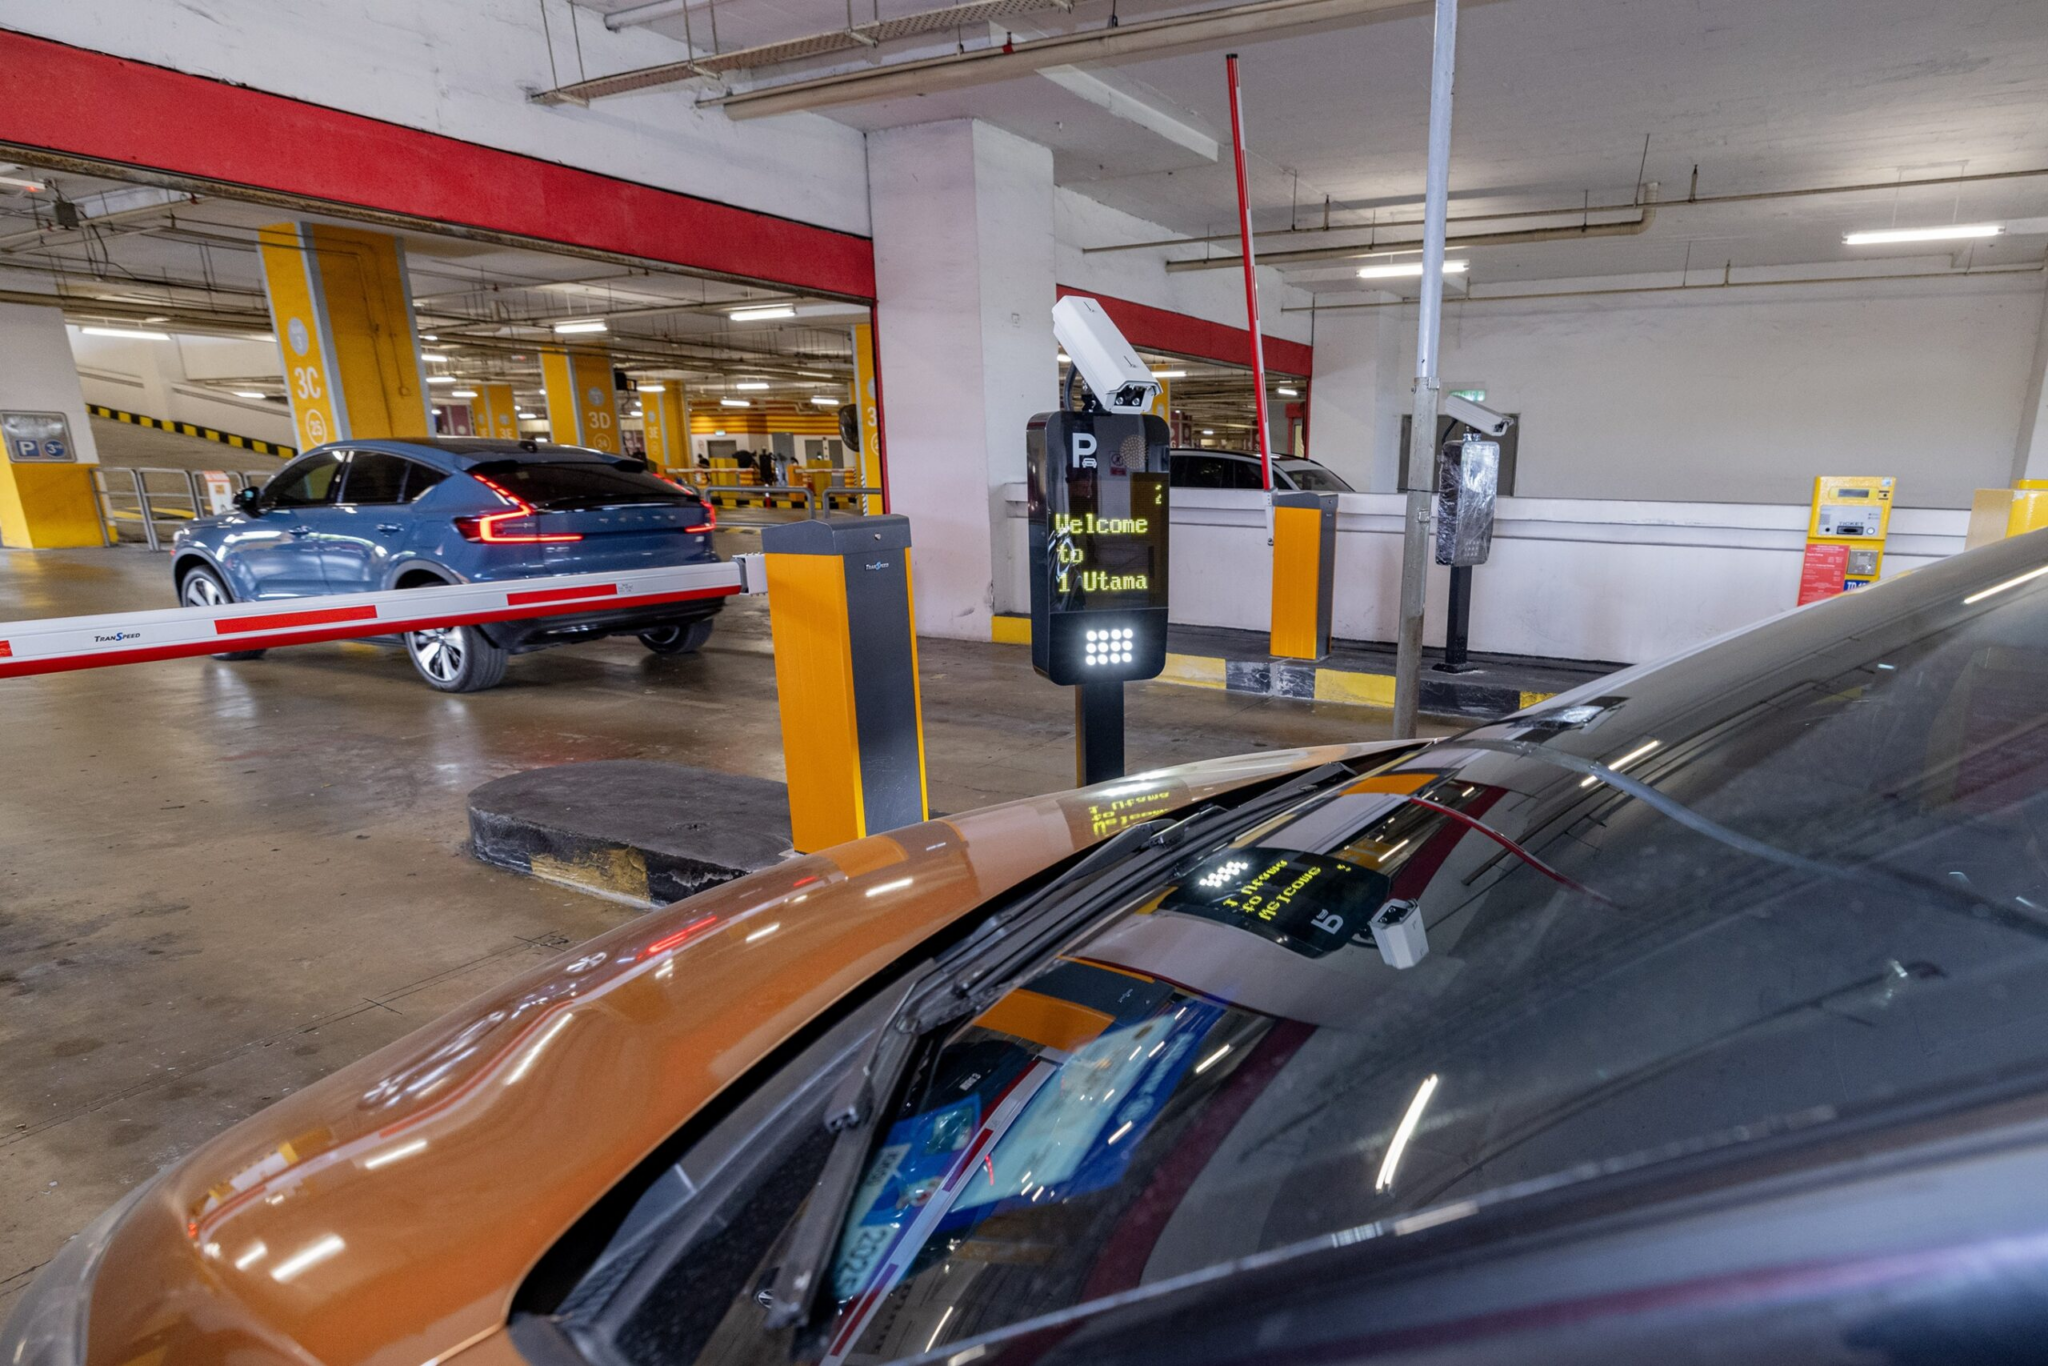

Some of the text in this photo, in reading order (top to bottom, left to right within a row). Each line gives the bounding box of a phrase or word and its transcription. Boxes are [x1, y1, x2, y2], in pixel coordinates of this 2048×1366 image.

[294, 366, 321, 399] 3C
[588, 411, 611, 429] 3D
[20, 441, 35, 455] P
[1072, 432, 1097, 468] P
[1054, 513, 1148, 534] Welcome
[1056, 544, 1084, 563] to
[1058, 571, 1148, 592] 1 Utama
